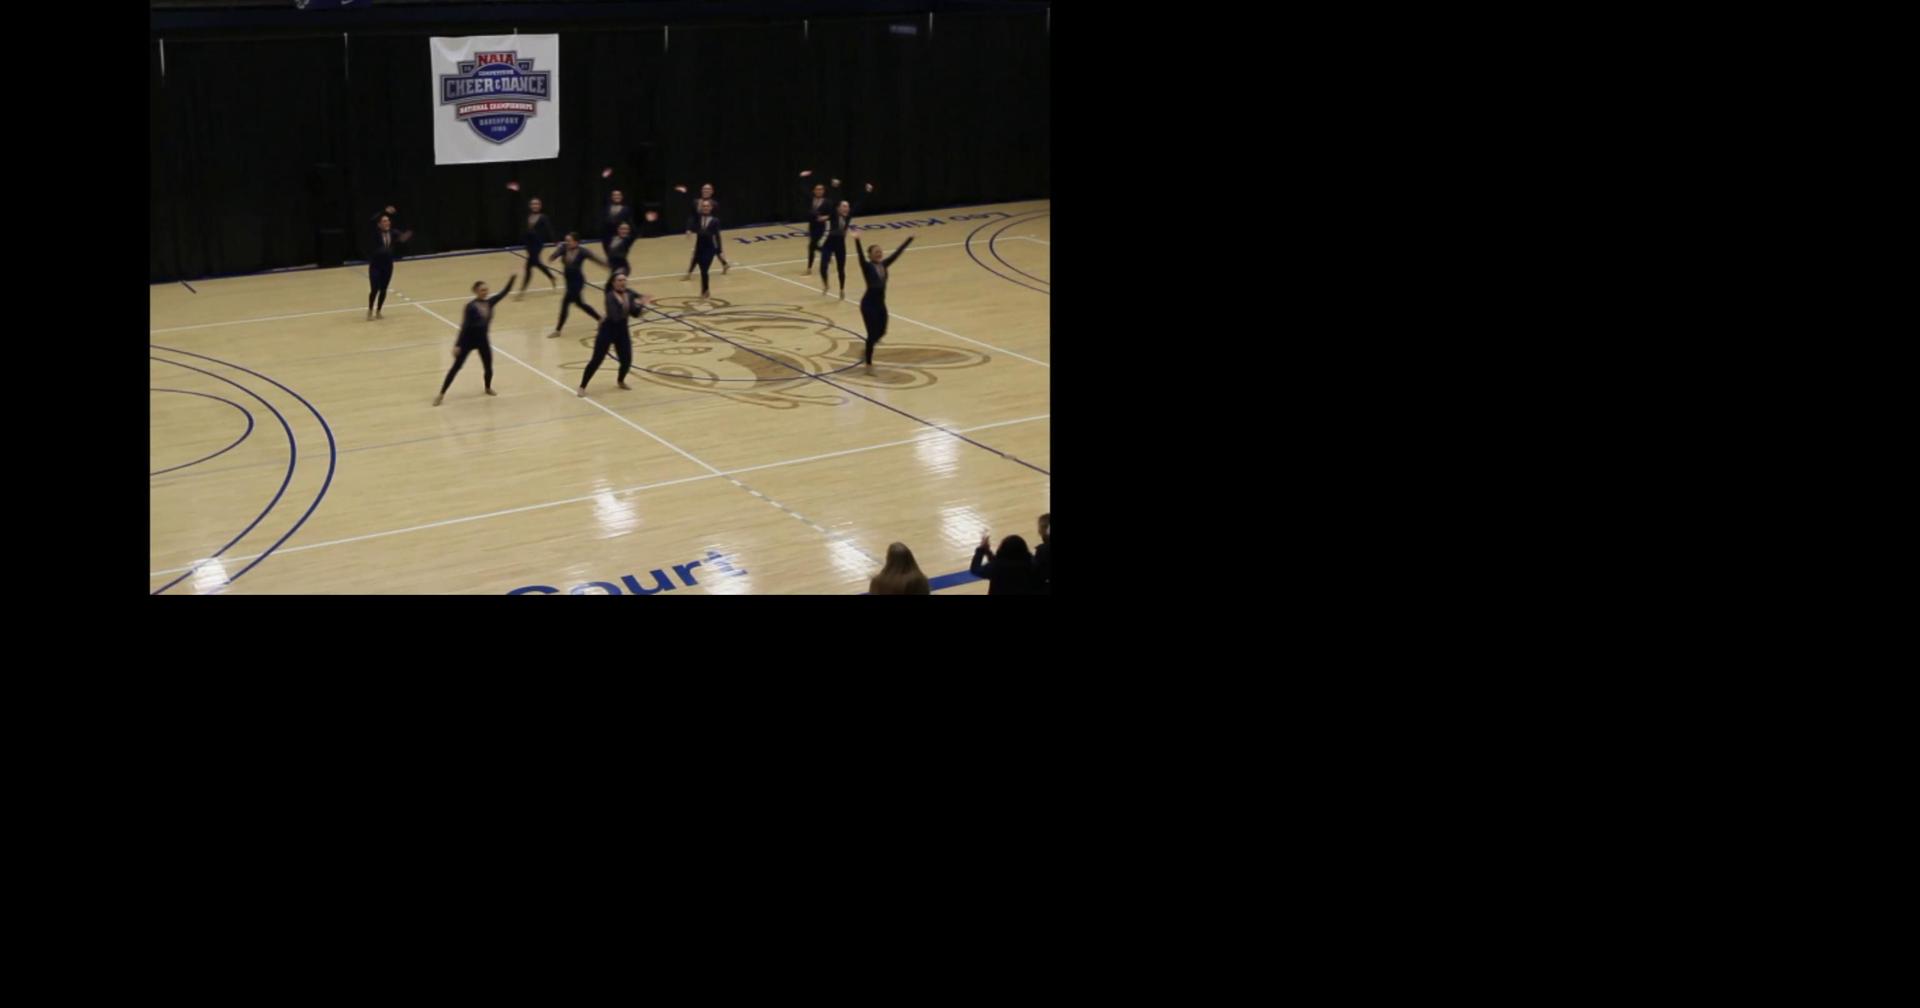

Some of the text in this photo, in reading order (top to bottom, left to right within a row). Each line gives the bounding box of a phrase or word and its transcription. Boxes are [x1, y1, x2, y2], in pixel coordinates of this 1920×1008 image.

[478, 53, 516, 65] NAIA
[446, 78, 494, 99] CHEER
[501, 76, 545, 94] DANCE
[459, 103, 533, 114] NATIONAL CHAMPIONSHIPS
[479, 117, 519, 126] DAVENPORT
[948, 212, 1012, 221] Leo
[733, 232, 811, 244] ourt
